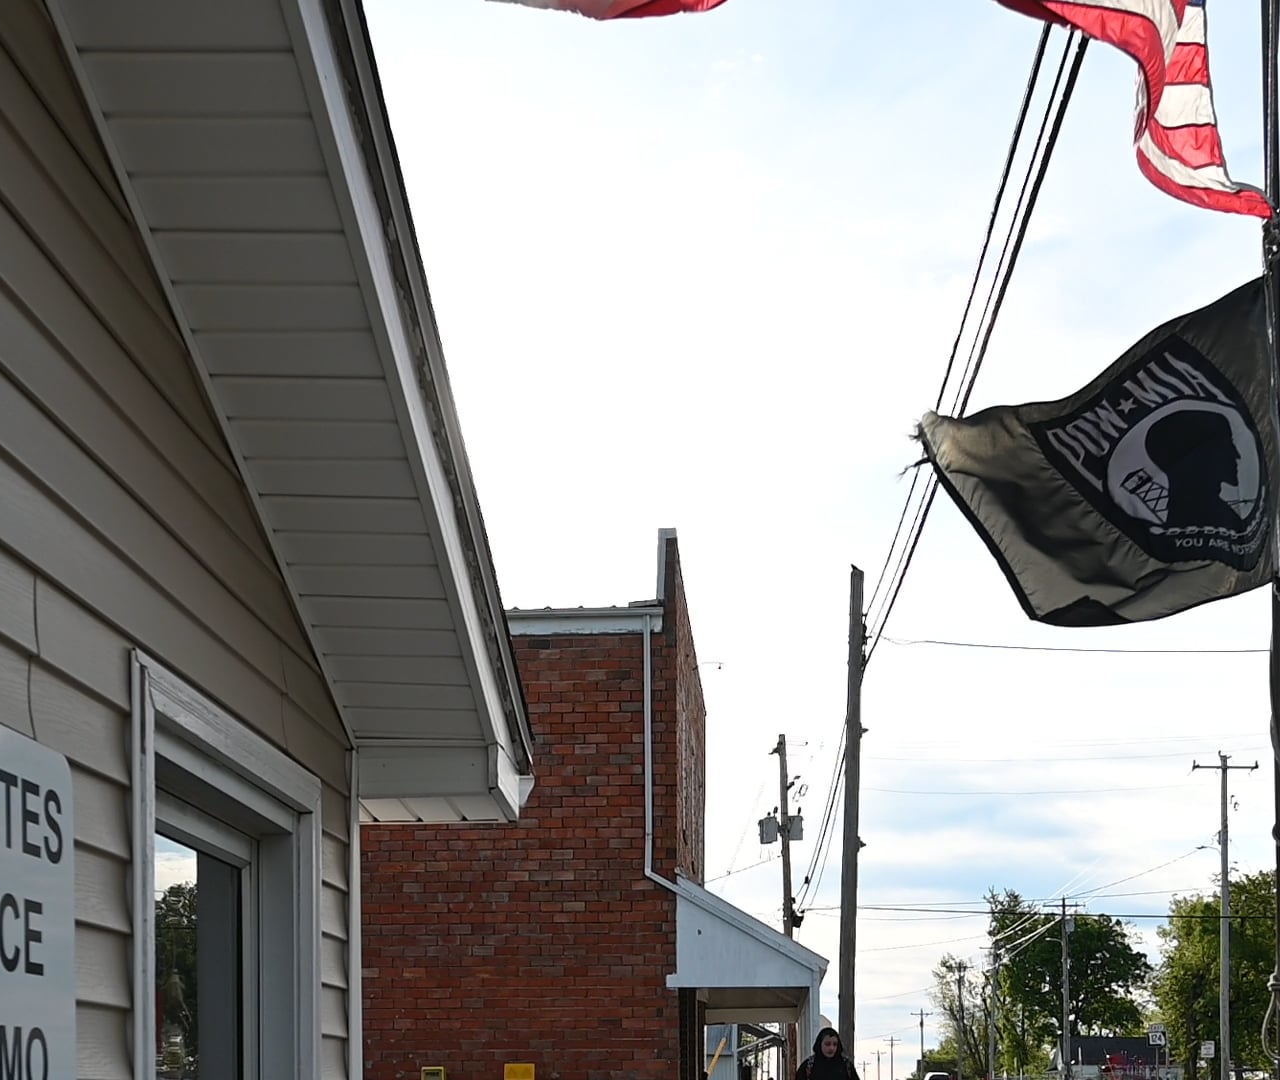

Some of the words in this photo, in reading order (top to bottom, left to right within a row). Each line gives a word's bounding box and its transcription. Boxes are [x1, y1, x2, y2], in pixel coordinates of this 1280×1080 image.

[1046, 398, 1129, 493] POW
[1123, 351, 1236, 408] MIA
[1175, 538, 1203, 547] YOU
[1151, 1034, 1162, 1043] 124
